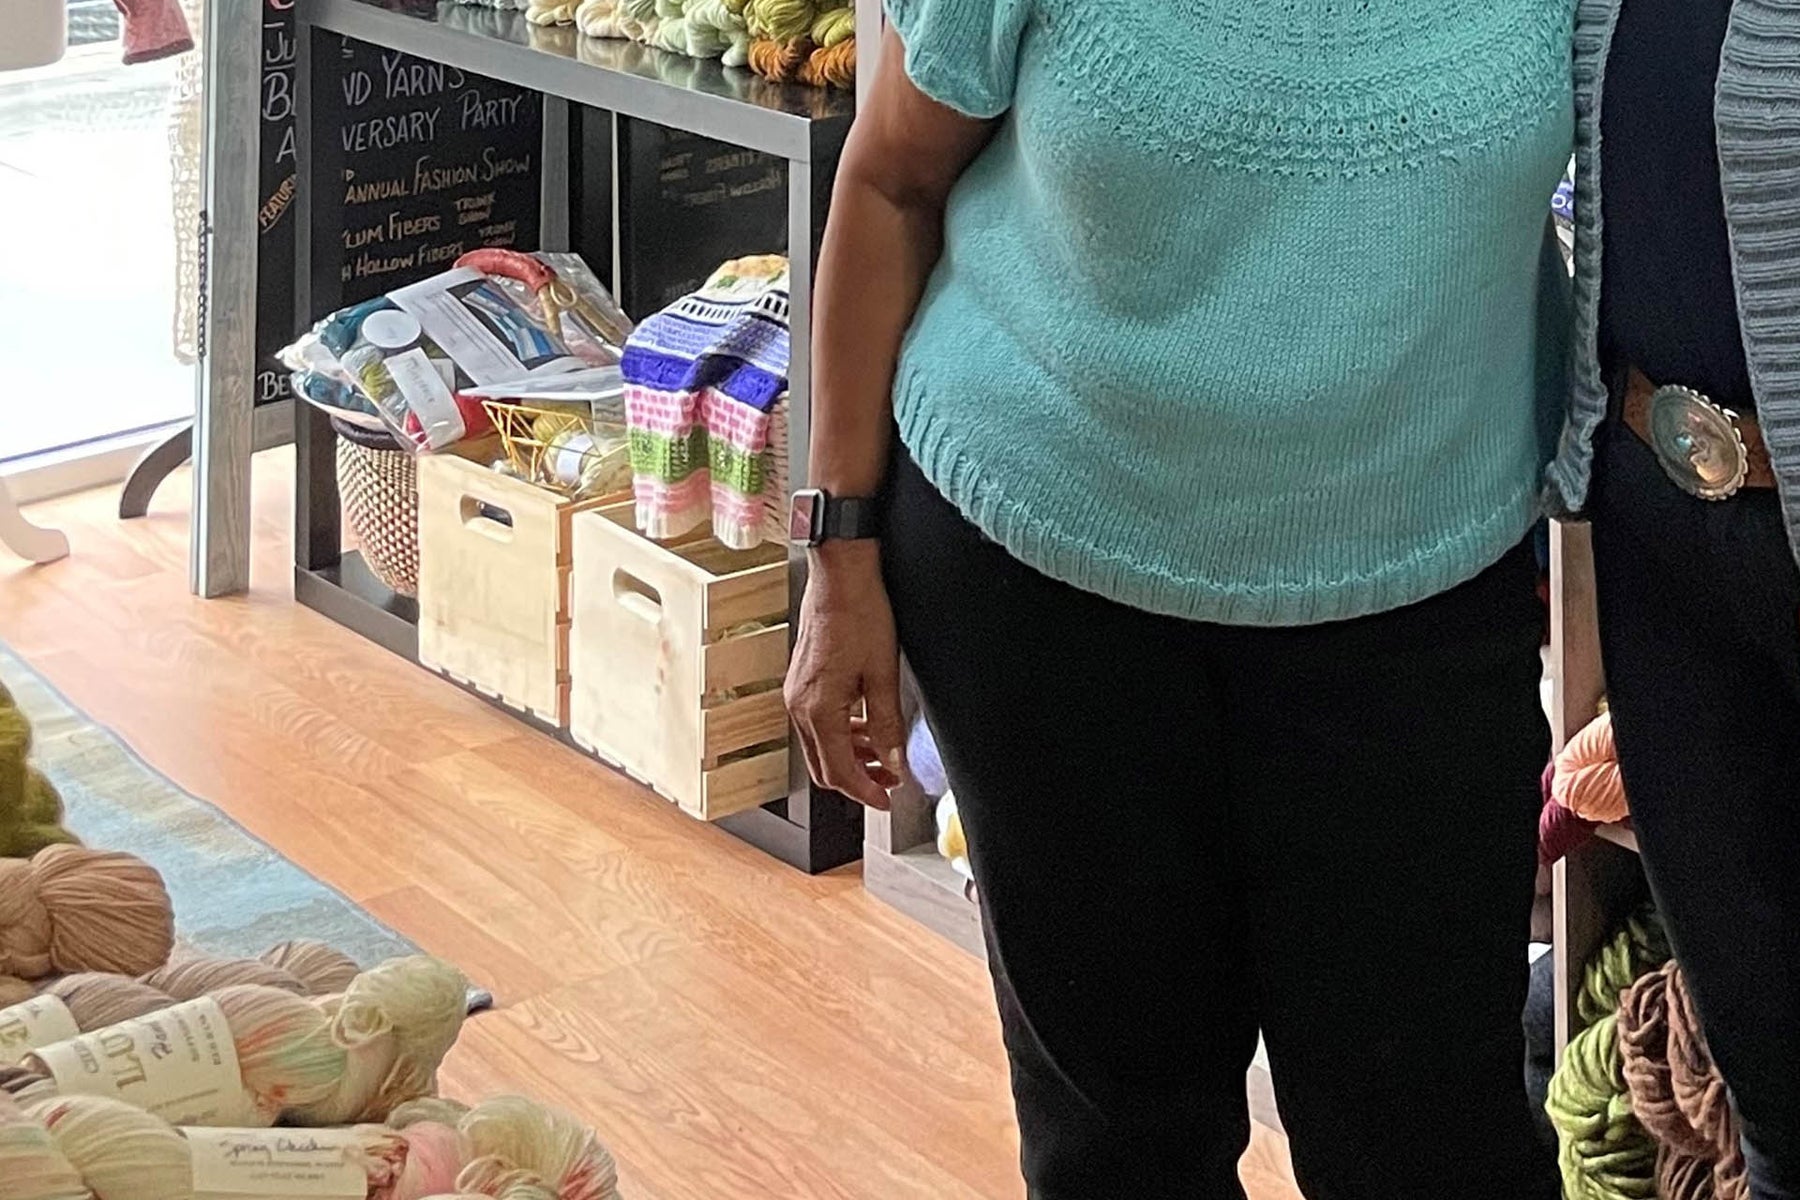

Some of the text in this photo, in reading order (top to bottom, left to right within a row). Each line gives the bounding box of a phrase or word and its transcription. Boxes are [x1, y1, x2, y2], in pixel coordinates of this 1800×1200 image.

[342, 107, 441, 151] VERSARY
[458, 89, 522, 131] PARTY
[344, 147, 530, 204] ANNUAL FASHION SHOW
